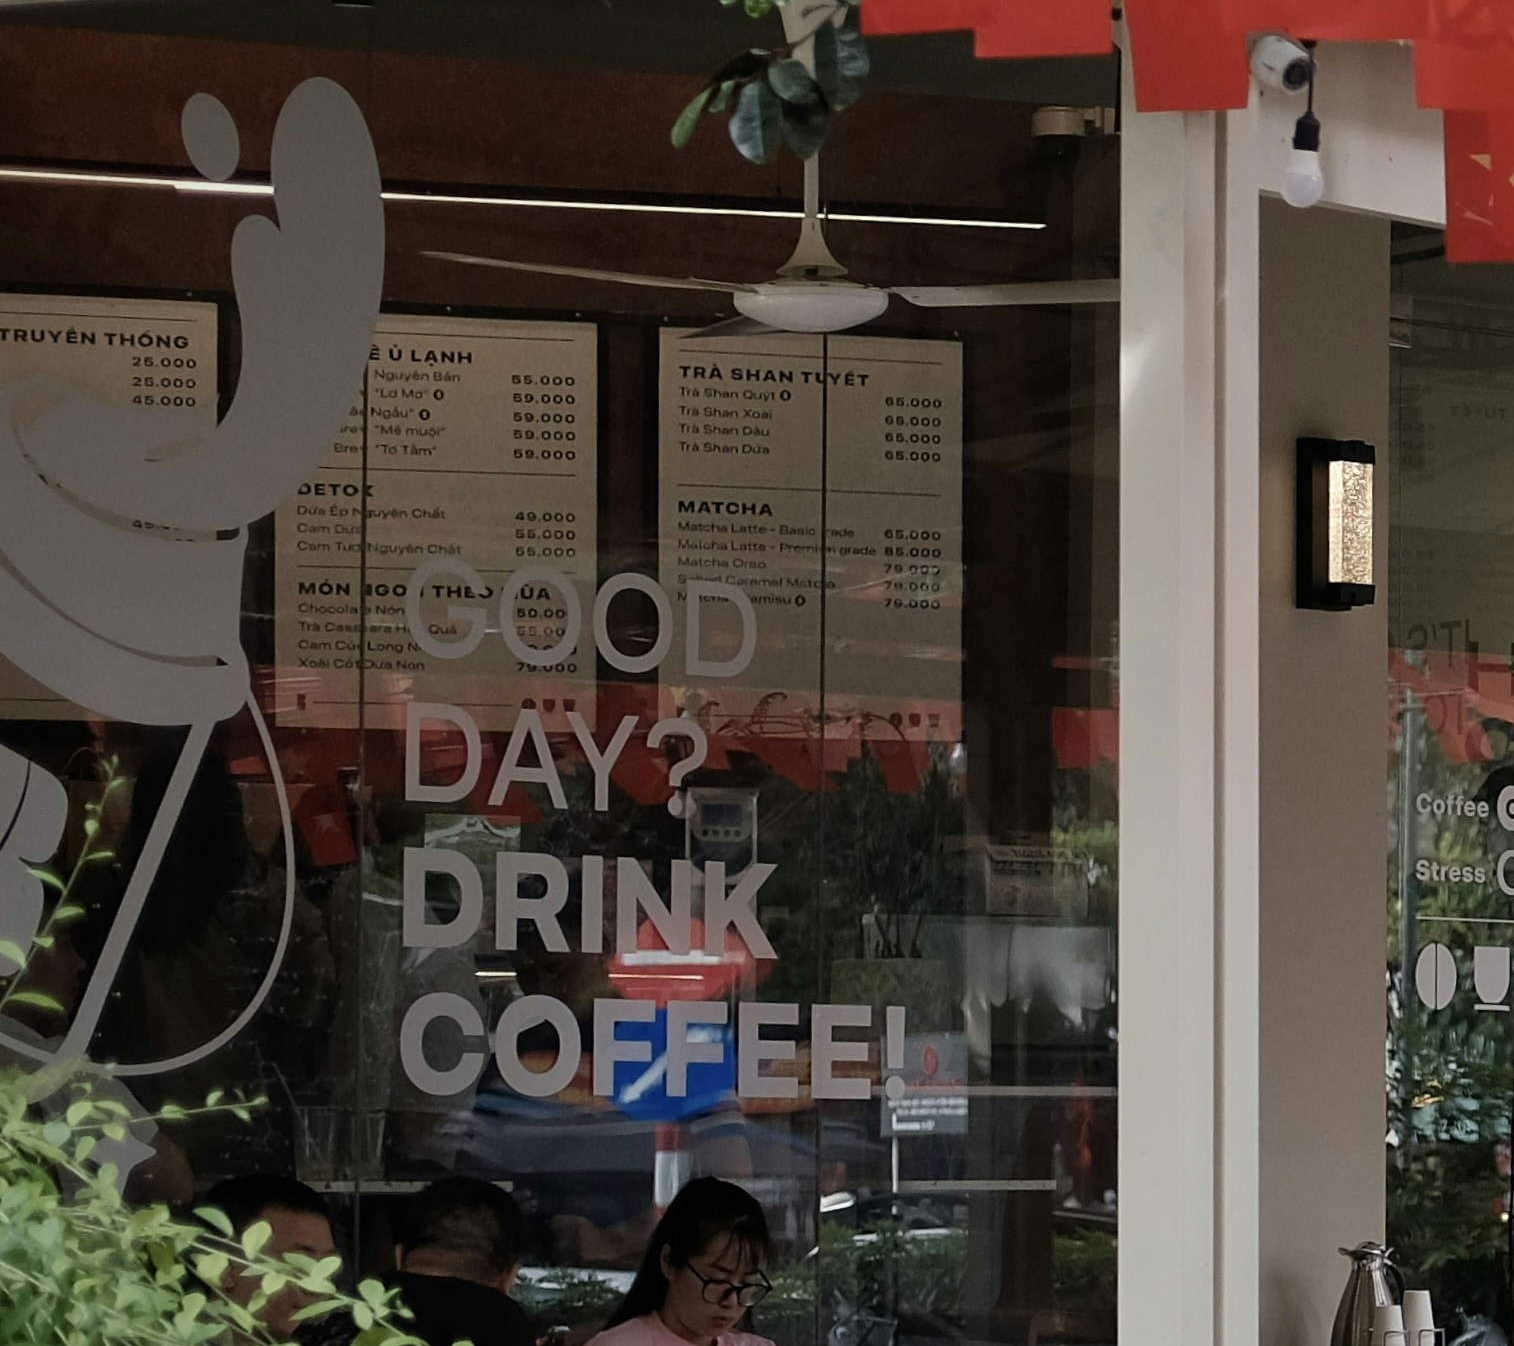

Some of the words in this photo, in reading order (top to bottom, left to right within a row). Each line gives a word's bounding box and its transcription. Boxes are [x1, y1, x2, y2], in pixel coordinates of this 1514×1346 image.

[104, 330, 189, 349] THỐNG
[132, 357, 197, 368] 25.000
[411, 348, 472, 368] LẠNH
[511, 375, 575, 386] 55.000
[679, 364, 723, 381] TRÀ
[730, 368, 793, 384] SHAN
[132, 377, 196, 388] 25.000
[132, 396, 196, 407] 45.000
[704, 387, 739, 400] Shan
[703, 406, 739, 419] Shan
[703, 423, 739, 436] Shan
[703, 441, 739, 455] Shan
[678, 500, 773, 516] MATCHA
[515, 512, 575, 523] 49.000
[678, 522, 728, 533] Matcha
[731, 523, 767, 535] Latte
[822, 527, 855, 539] rade
[678, 557, 729, 569] Matcha
[298, 578, 350, 597] MÓN
[298, 603, 371, 615] Chocolae
[517, 608, 566, 619] 50.00
[403, 561, 758, 679] GOOD
[404, 700, 709, 819] DAY?
[1416, 792, 1489, 818] Coffee
[1416, 859, 1486, 883] Stress
[403, 848, 778, 961] DRINK
[400, 991, 908, 1101] COFFEE!
